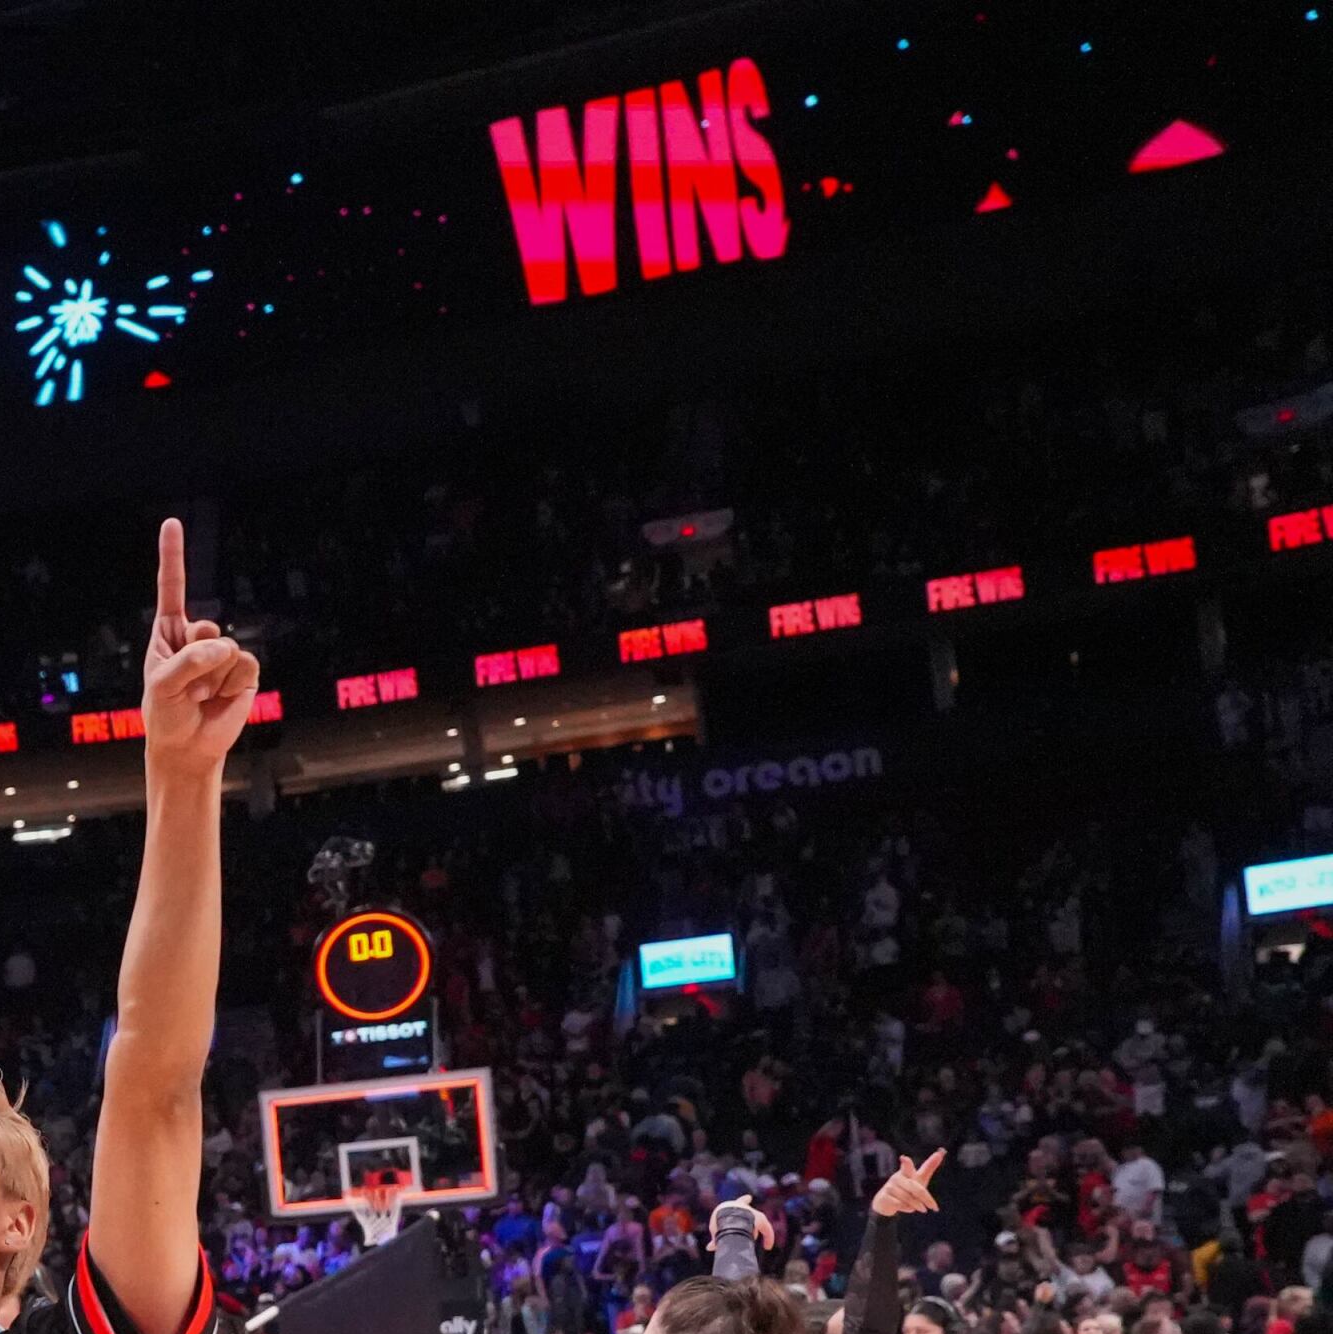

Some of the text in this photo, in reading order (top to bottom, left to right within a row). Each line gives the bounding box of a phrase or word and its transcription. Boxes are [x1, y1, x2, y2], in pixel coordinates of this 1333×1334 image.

[489, 57, 789, 305] WINS
[349, 929, 394, 962] 0.0
[357, 1021, 427, 1043] TISSOT
